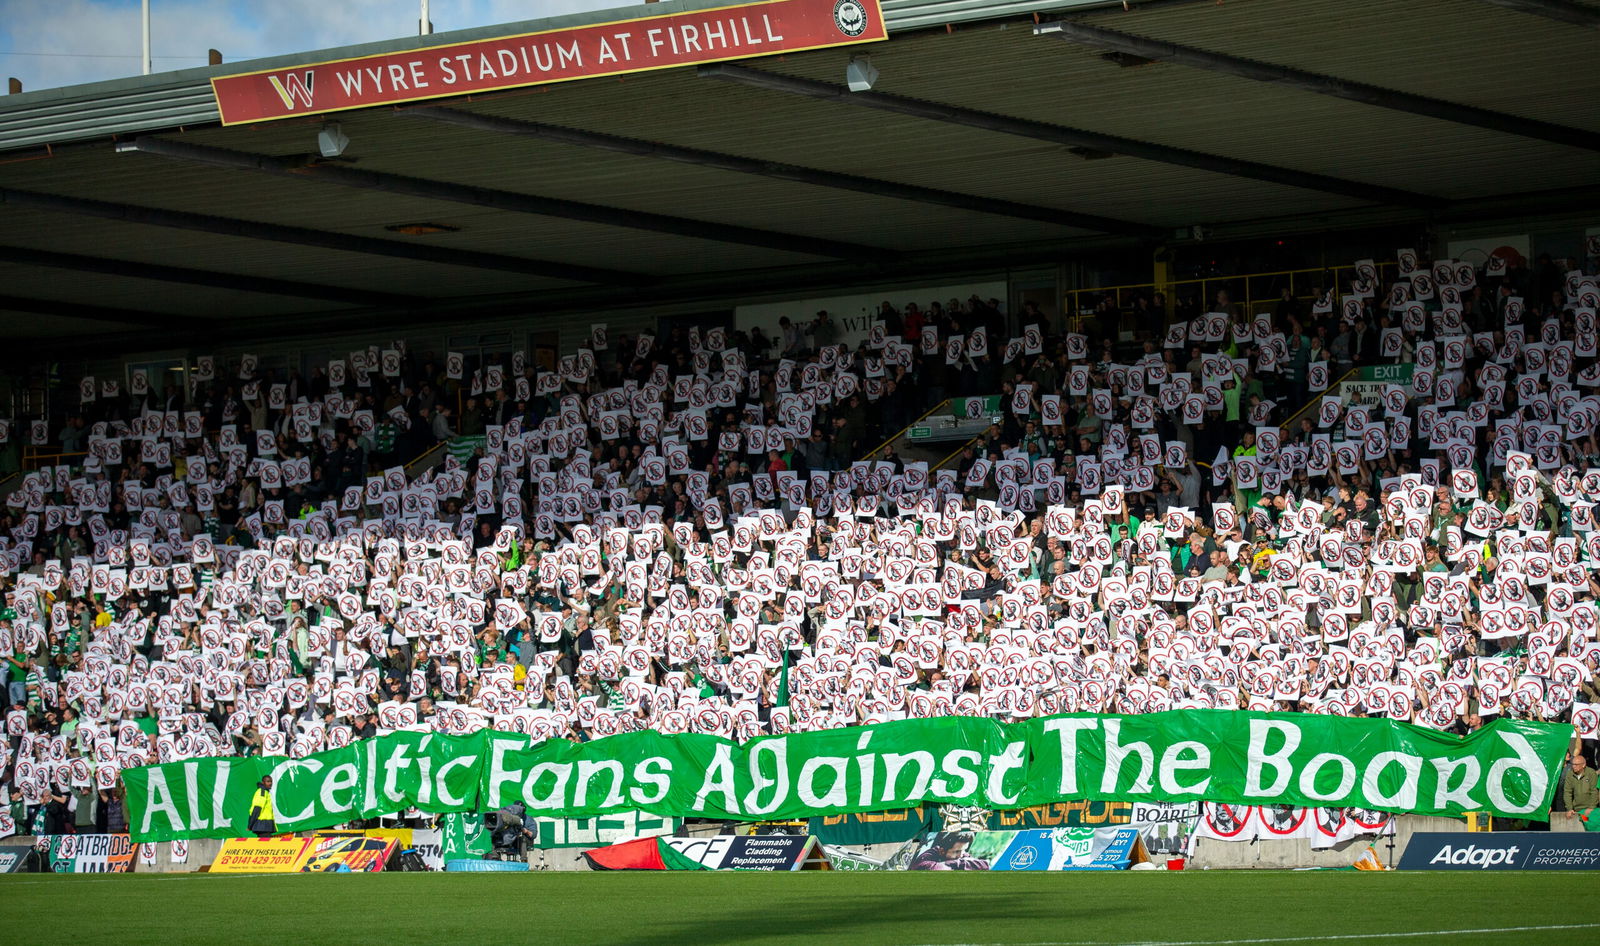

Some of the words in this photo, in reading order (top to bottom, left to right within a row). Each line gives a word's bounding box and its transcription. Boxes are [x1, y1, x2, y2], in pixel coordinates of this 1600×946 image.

[335, 60, 428, 98] WYRE
[440, 40, 582, 85] STADIUM
[598, 33, 632, 65] AT
[647, 14, 784, 57] FIRHILL
[1375, 366, 1401, 378] EXIT
[1346, 385, 1366, 393] SACK
[141, 760, 231, 834] All
[272, 731, 476, 826] Celtic
[489, 738, 670, 810] Fans
[695, 728, 1025, 815] Against
[1043, 717, 1211, 795] The
[1244, 719, 1549, 813] Board
[745, 838, 793, 847] Flammable
[745, 848, 783, 856] Cladding
[231, 856, 251, 864] 0141
[252, 856, 268, 864] 429
[270, 856, 292, 864] 7070
[731, 857, 787, 865] Replacement
[1429, 845, 1520, 869] Adapt
[1533, 857, 1597, 865] PROPERTY
